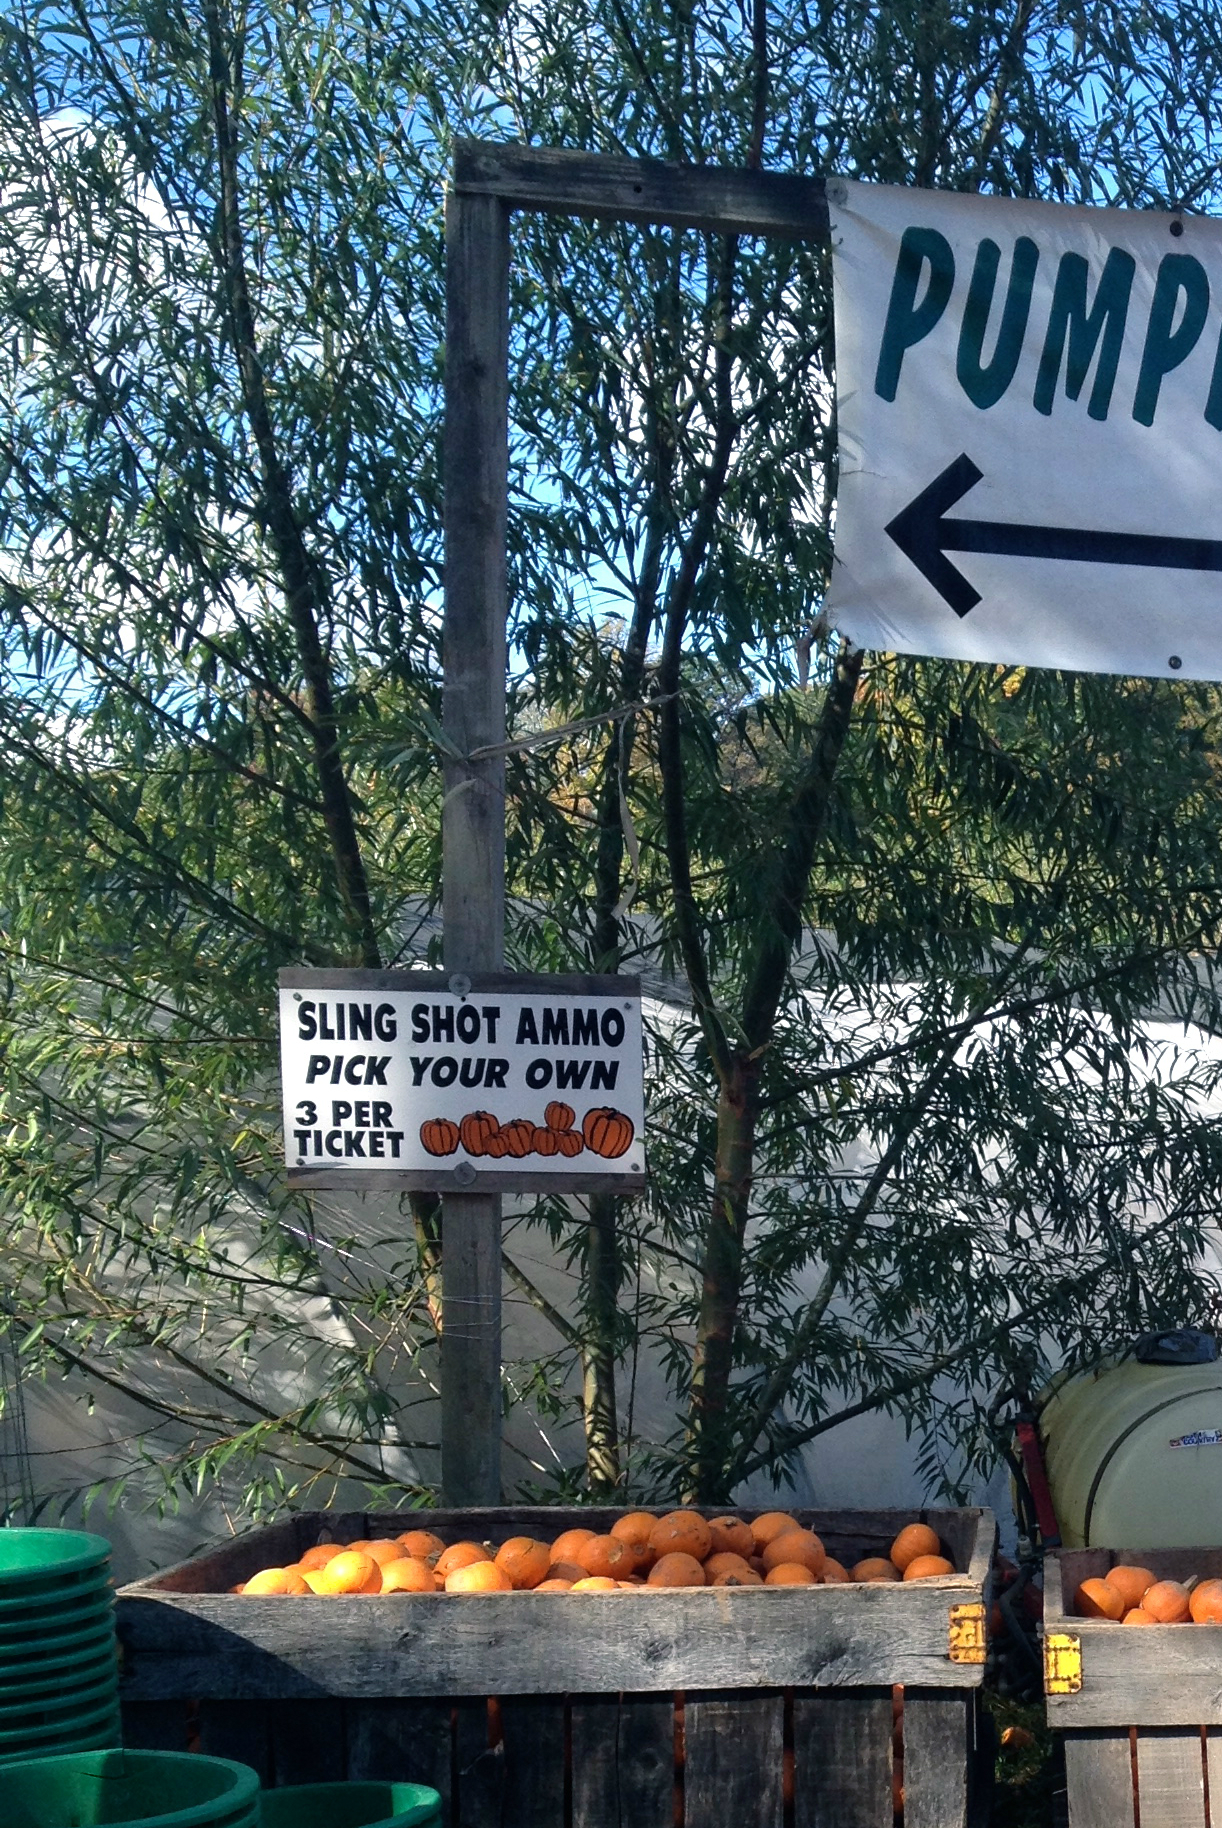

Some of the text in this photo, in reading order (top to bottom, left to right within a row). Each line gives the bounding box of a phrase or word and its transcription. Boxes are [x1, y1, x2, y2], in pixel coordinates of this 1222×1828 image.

[298, 1000, 626, 1048] SLING SHOT AMMO
[305, 1054, 620, 1091] PICK YOUR OWN
[295, 1100, 394, 1128] 3 PER
[293, 1129, 404, 1159] TICKET
